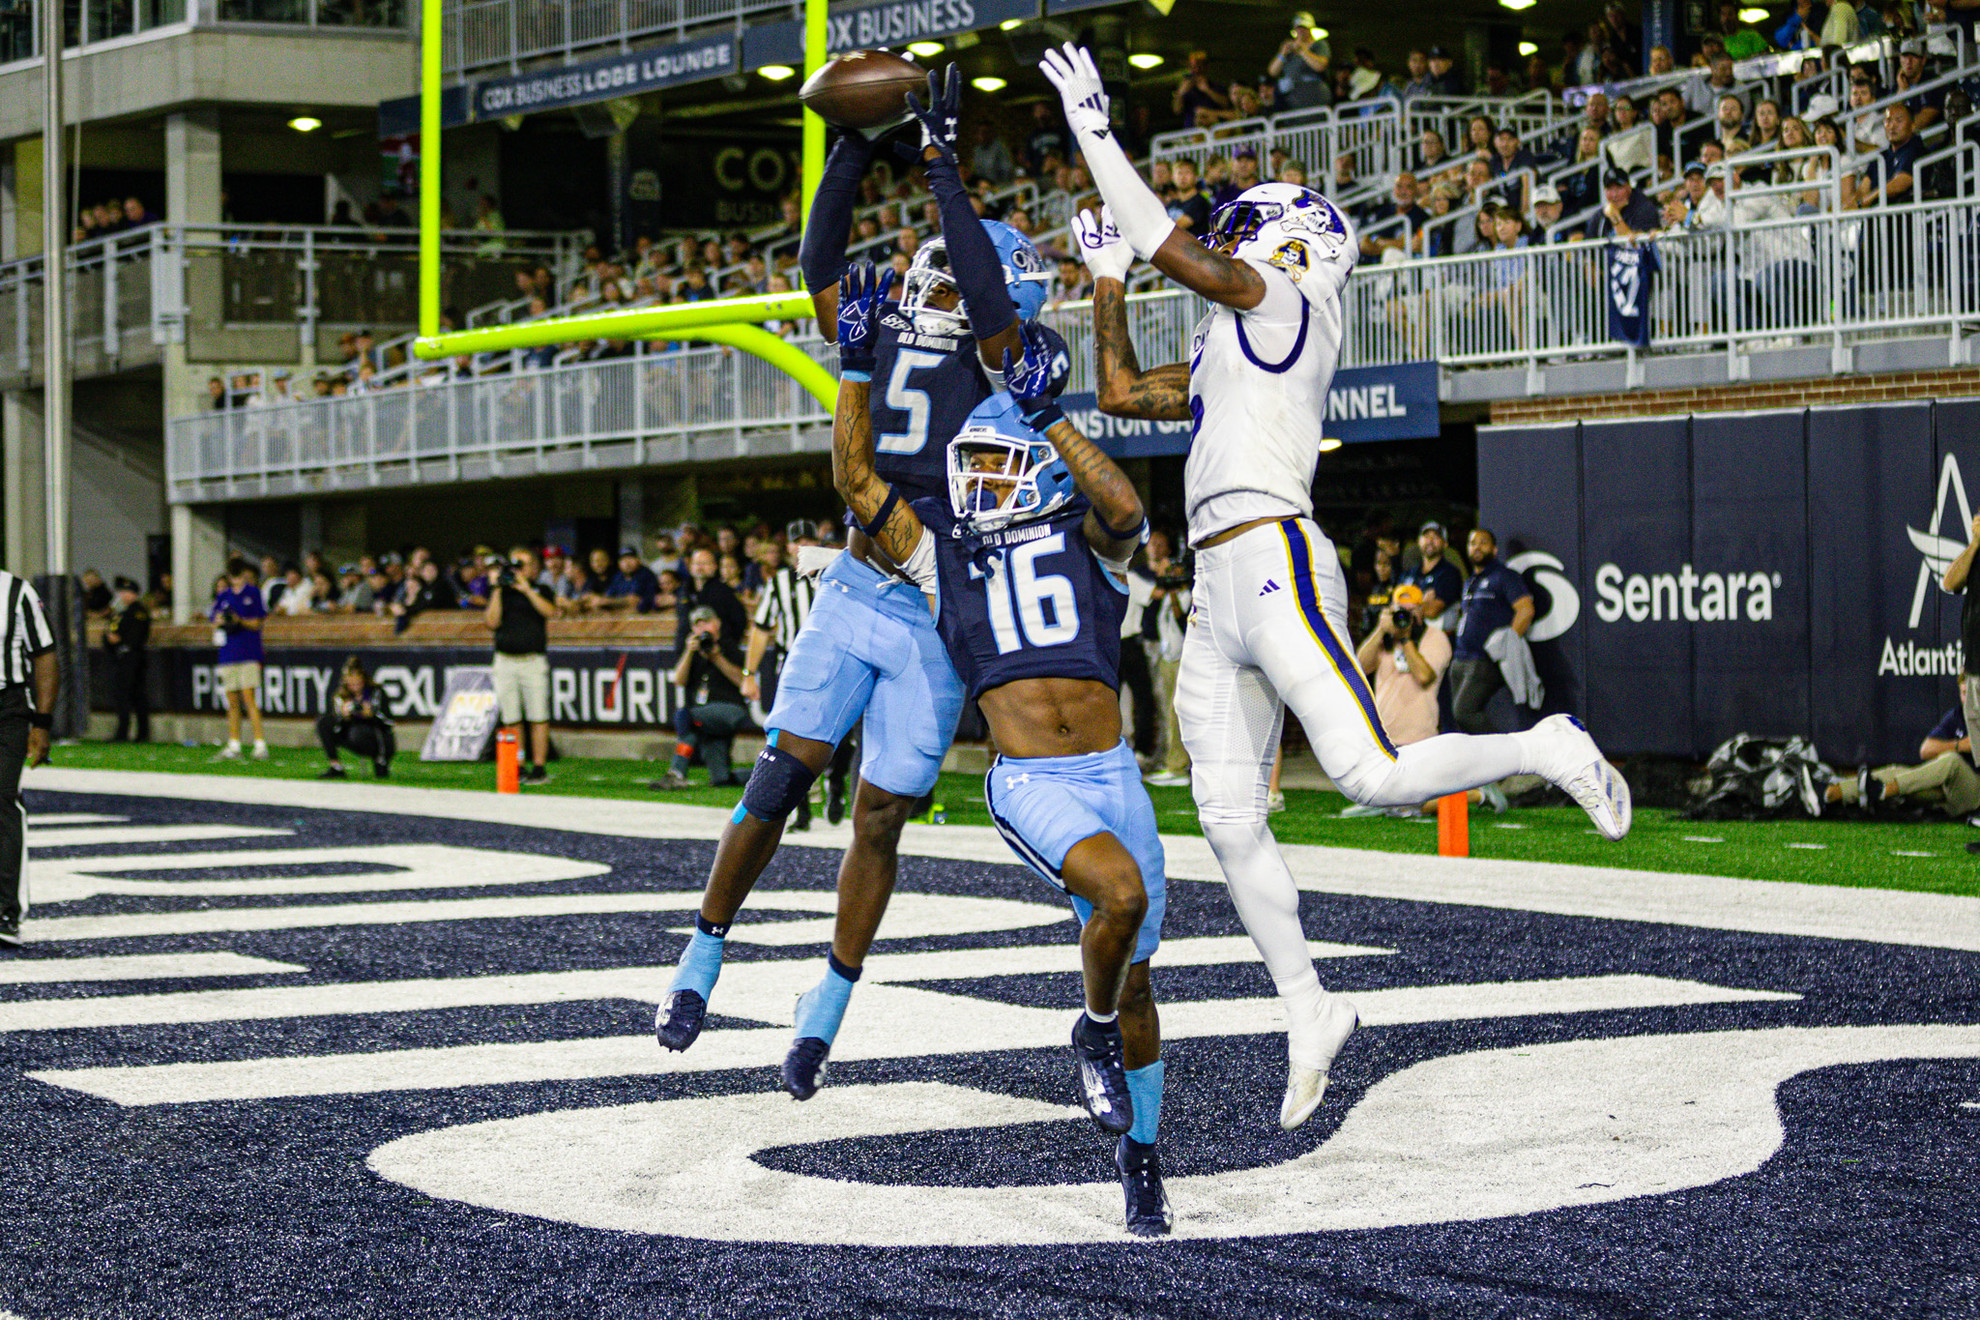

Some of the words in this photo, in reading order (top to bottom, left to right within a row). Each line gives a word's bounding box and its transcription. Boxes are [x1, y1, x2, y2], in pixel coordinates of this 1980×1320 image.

[857, 0, 976, 46] BUSINESS
[482, 87, 513, 111] COX
[515, 73, 582, 105] BUSINESS
[583, 63, 638, 92] LOGE
[642, 44, 731, 80] LOUNGE
[876, 347, 932, 456] 5
[1322, 384, 1407, 421] NNEL
[1004, 523, 1052, 545] DOMINION
[968, 531, 1081, 656] 16
[1595, 563, 1774, 623] Sentara
[1878, 634, 1966, 677] Atlanti
